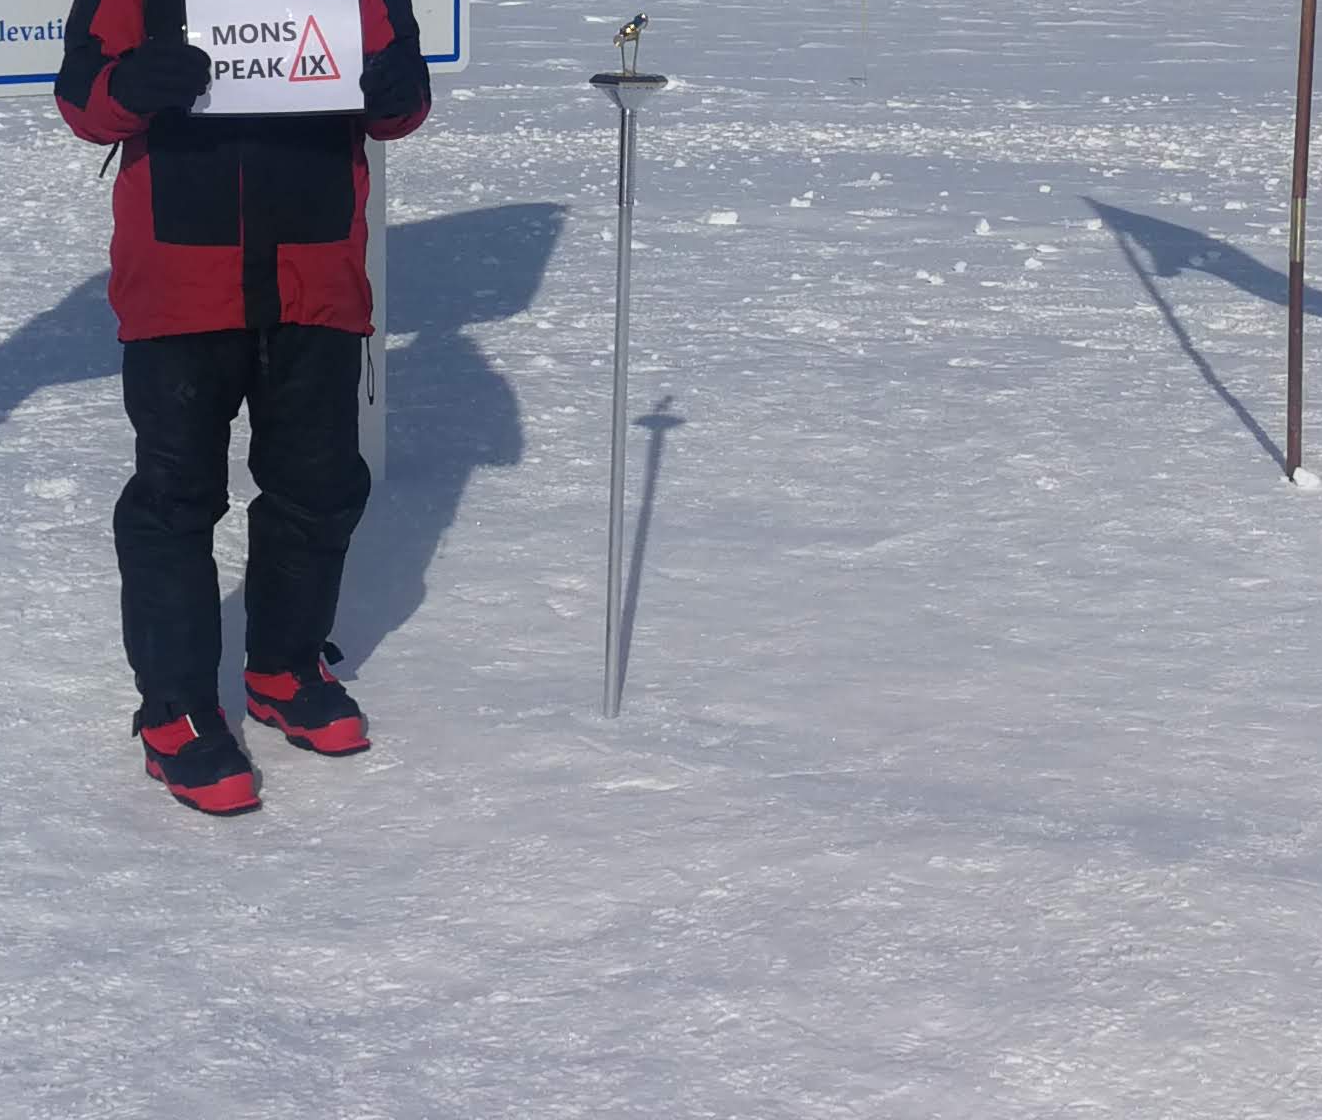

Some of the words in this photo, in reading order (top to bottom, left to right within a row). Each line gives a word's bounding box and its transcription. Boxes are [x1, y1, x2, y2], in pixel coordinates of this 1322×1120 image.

[211, 21, 297, 46] MONS
[214, 56, 285, 81] PEAK
[301, 54, 327, 77] IX
